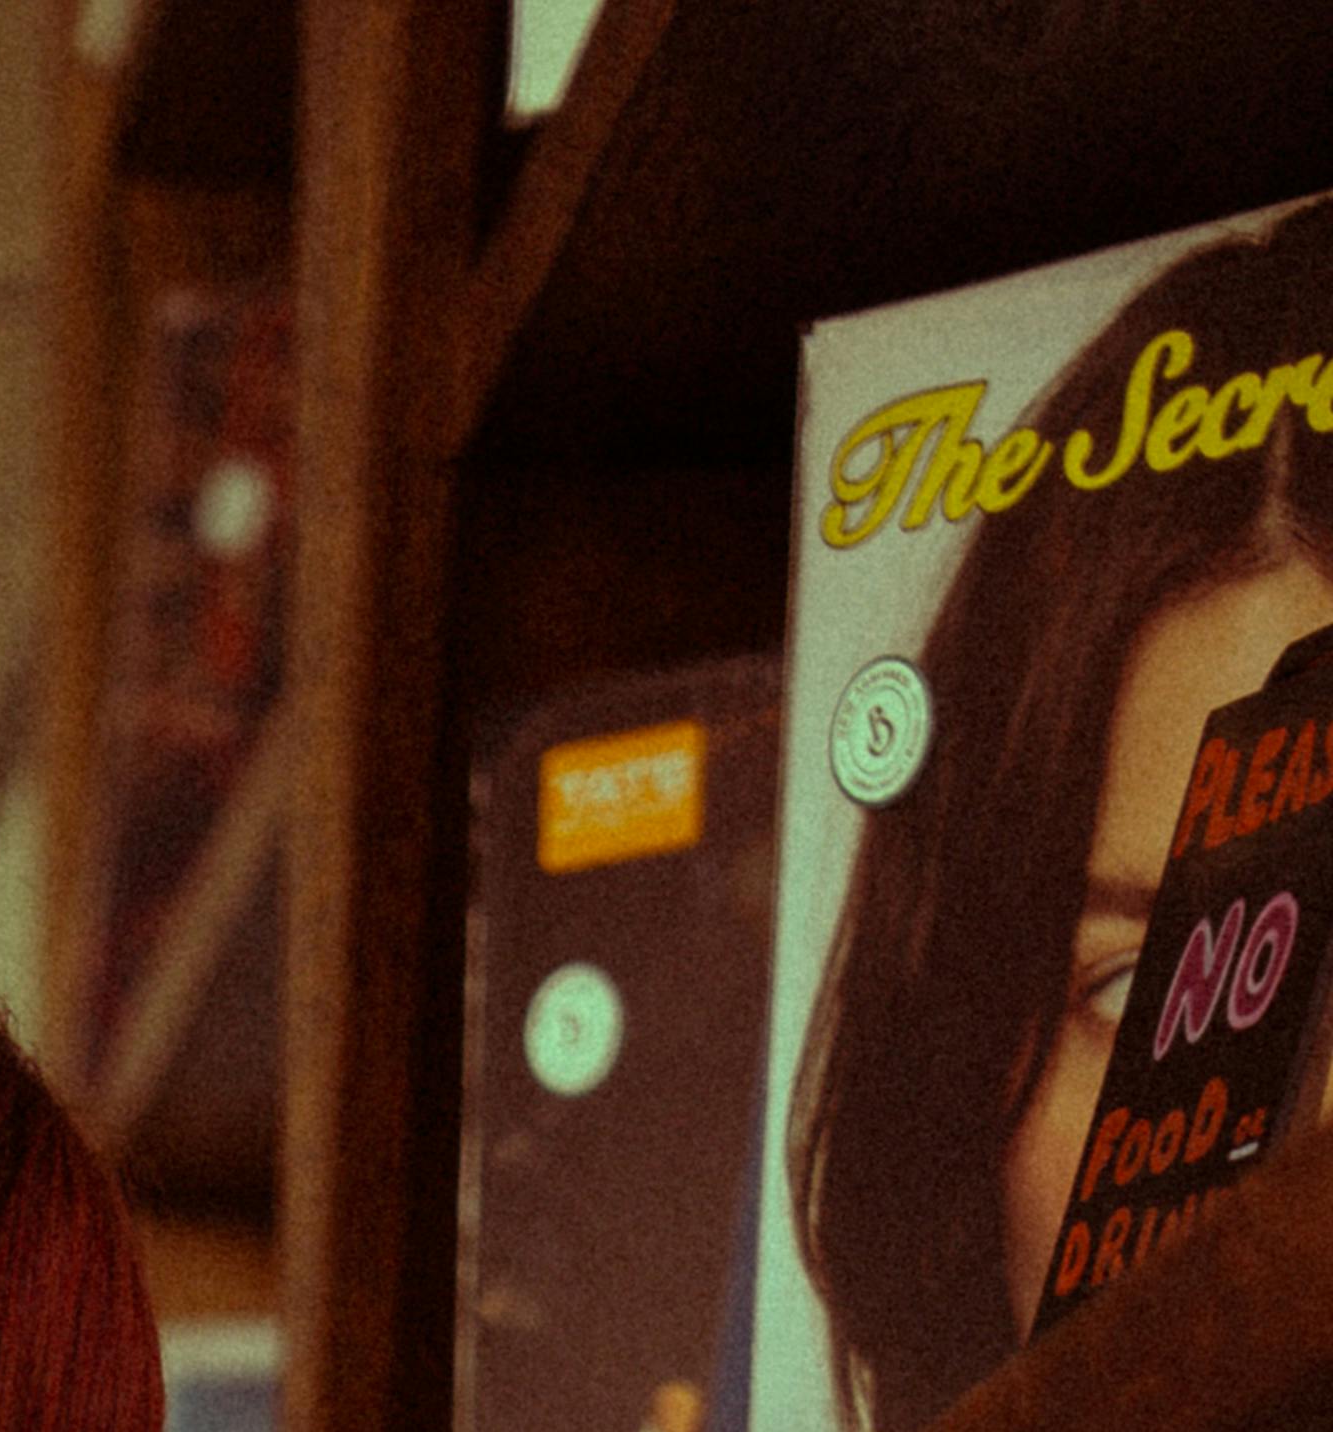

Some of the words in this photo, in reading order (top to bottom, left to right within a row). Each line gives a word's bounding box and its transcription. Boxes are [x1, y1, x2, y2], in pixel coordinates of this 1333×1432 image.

[820, 379, 1054, 550] The
[1153, 892, 1298, 1062] NO
[1081, 1076, 1229, 1201] FOOD
